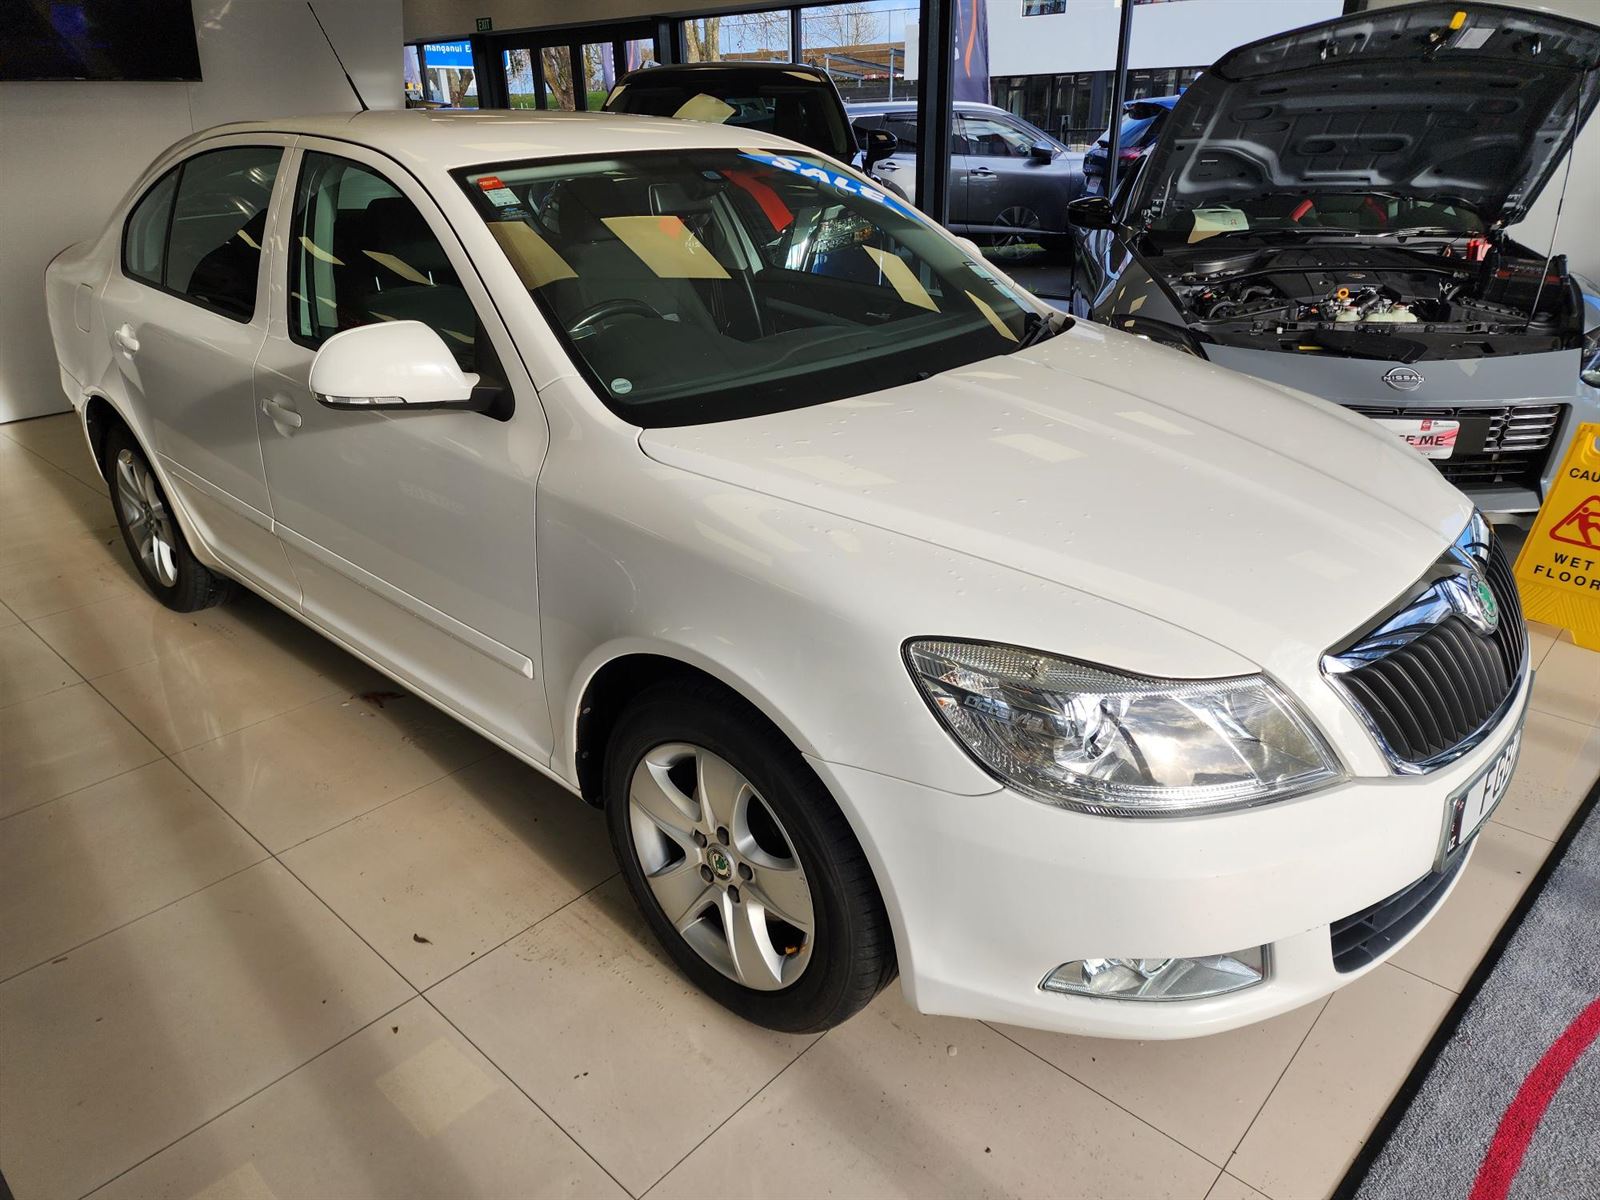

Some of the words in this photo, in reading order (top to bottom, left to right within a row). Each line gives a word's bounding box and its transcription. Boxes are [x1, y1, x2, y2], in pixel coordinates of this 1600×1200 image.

[478, 19, 490, 30] EXIT
[771, 156, 886, 203] SALE
[1418, 435, 1445, 446] ME
[1554, 552, 1595, 571] WET
[1533, 564, 1600, 591] FLOOR
